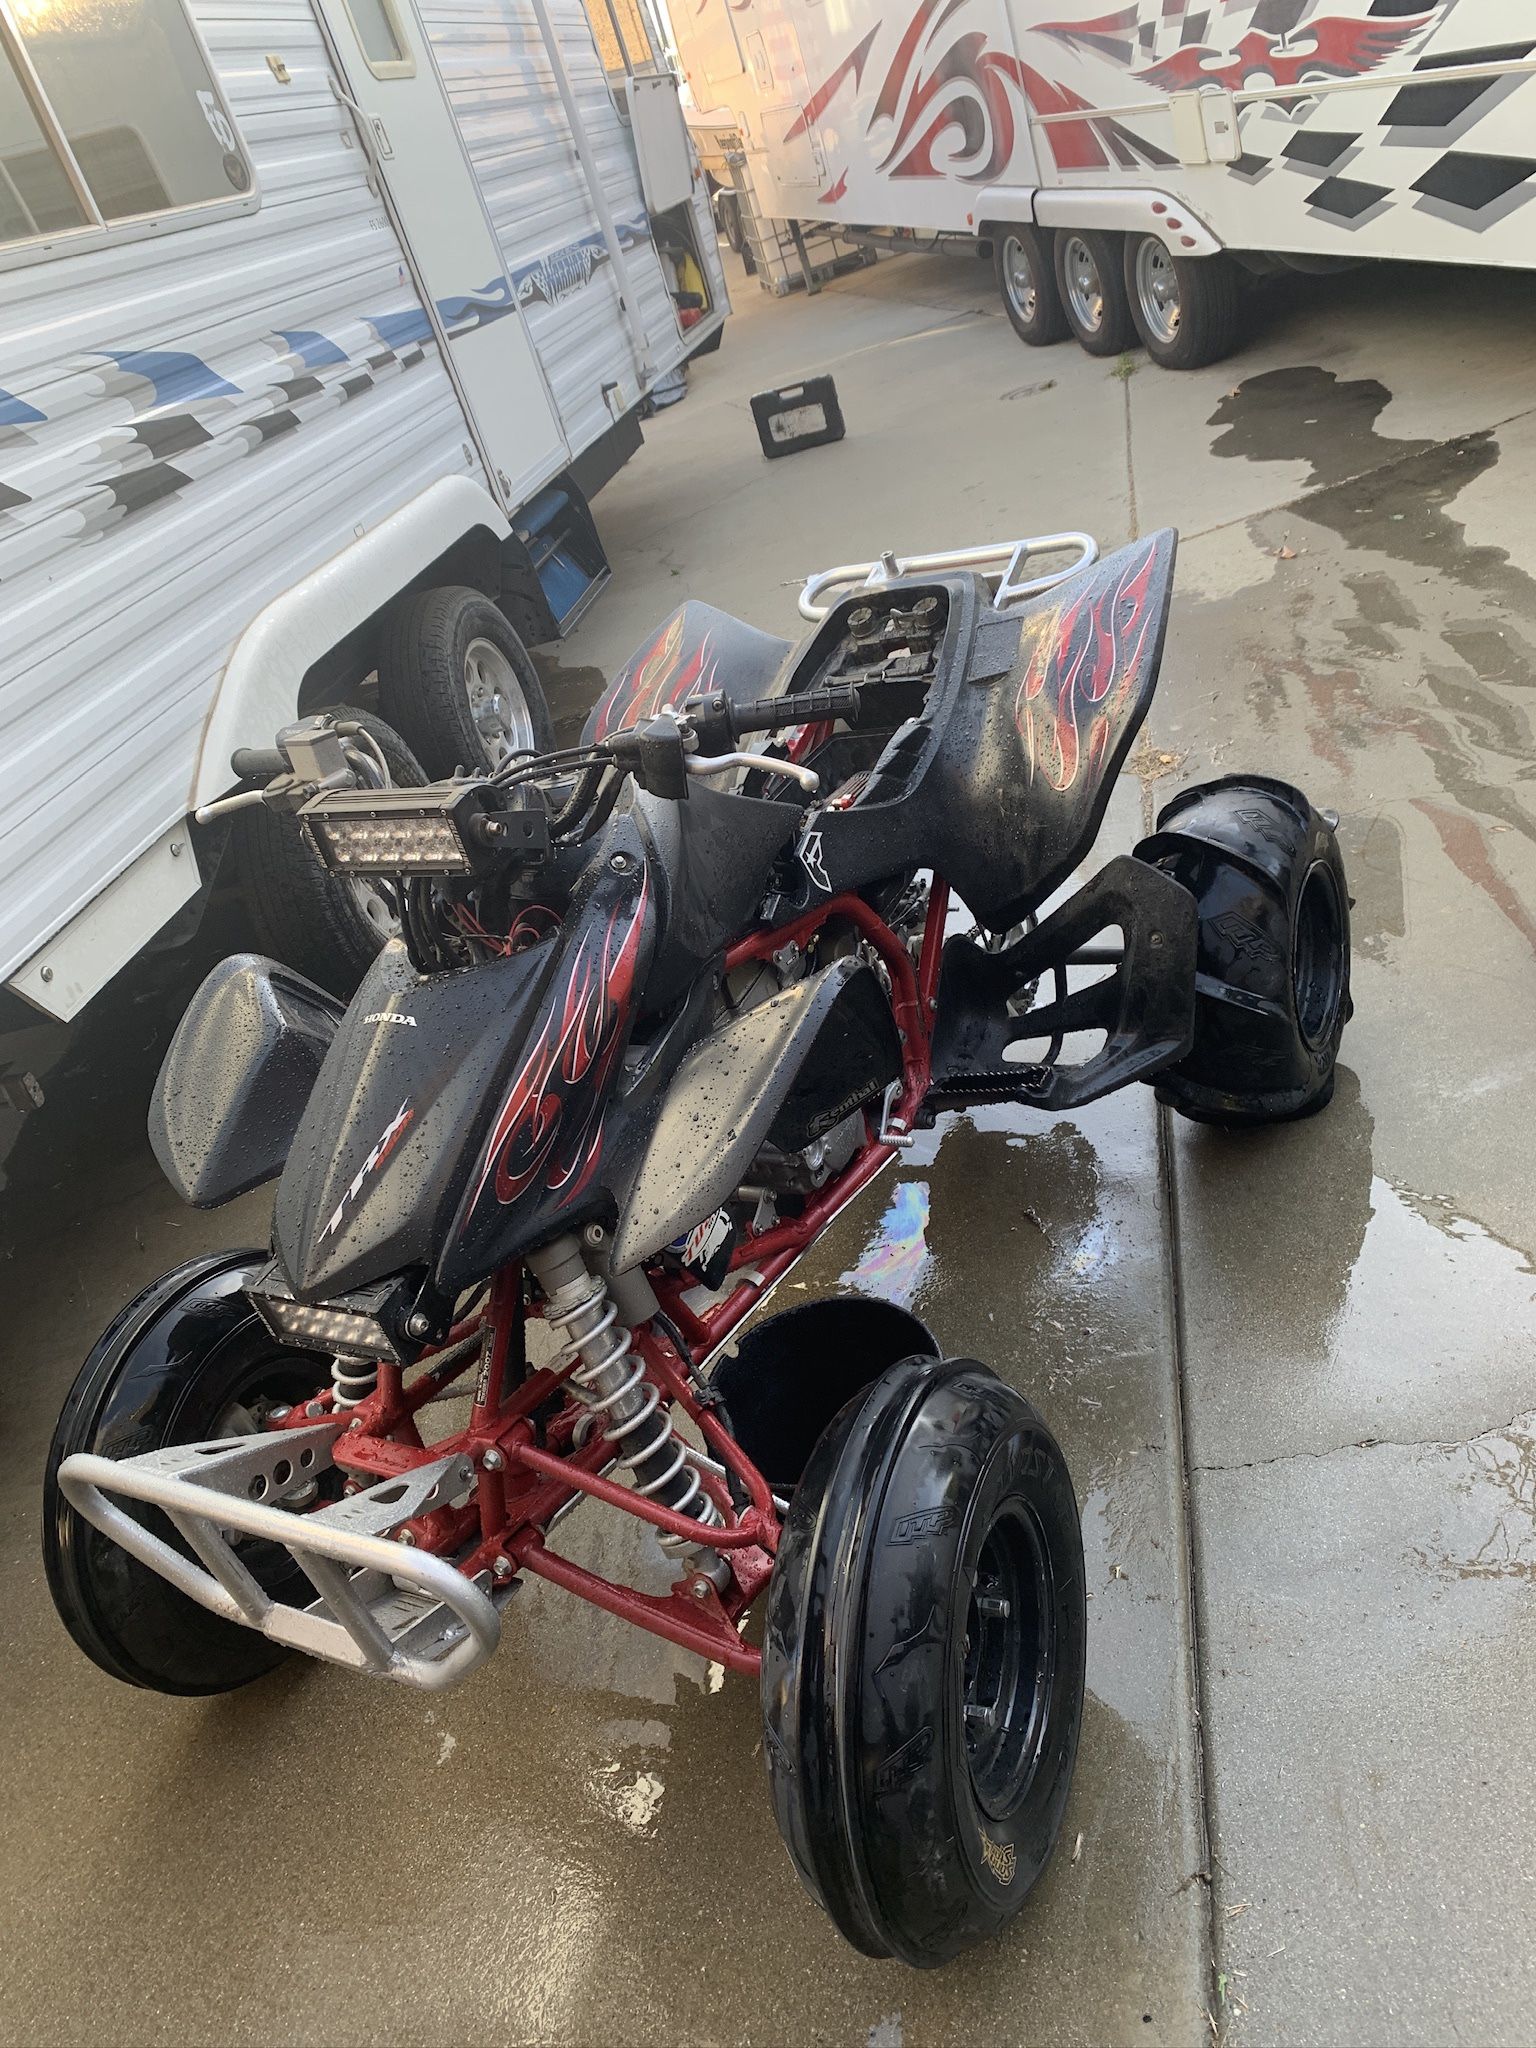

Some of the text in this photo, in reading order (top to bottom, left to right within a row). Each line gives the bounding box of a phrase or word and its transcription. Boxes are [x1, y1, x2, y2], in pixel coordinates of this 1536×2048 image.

[363, 1012, 418, 1027] HONDA
[807, 1078, 880, 1137] Renthal
[483, 1350, 492, 1376] 2007
